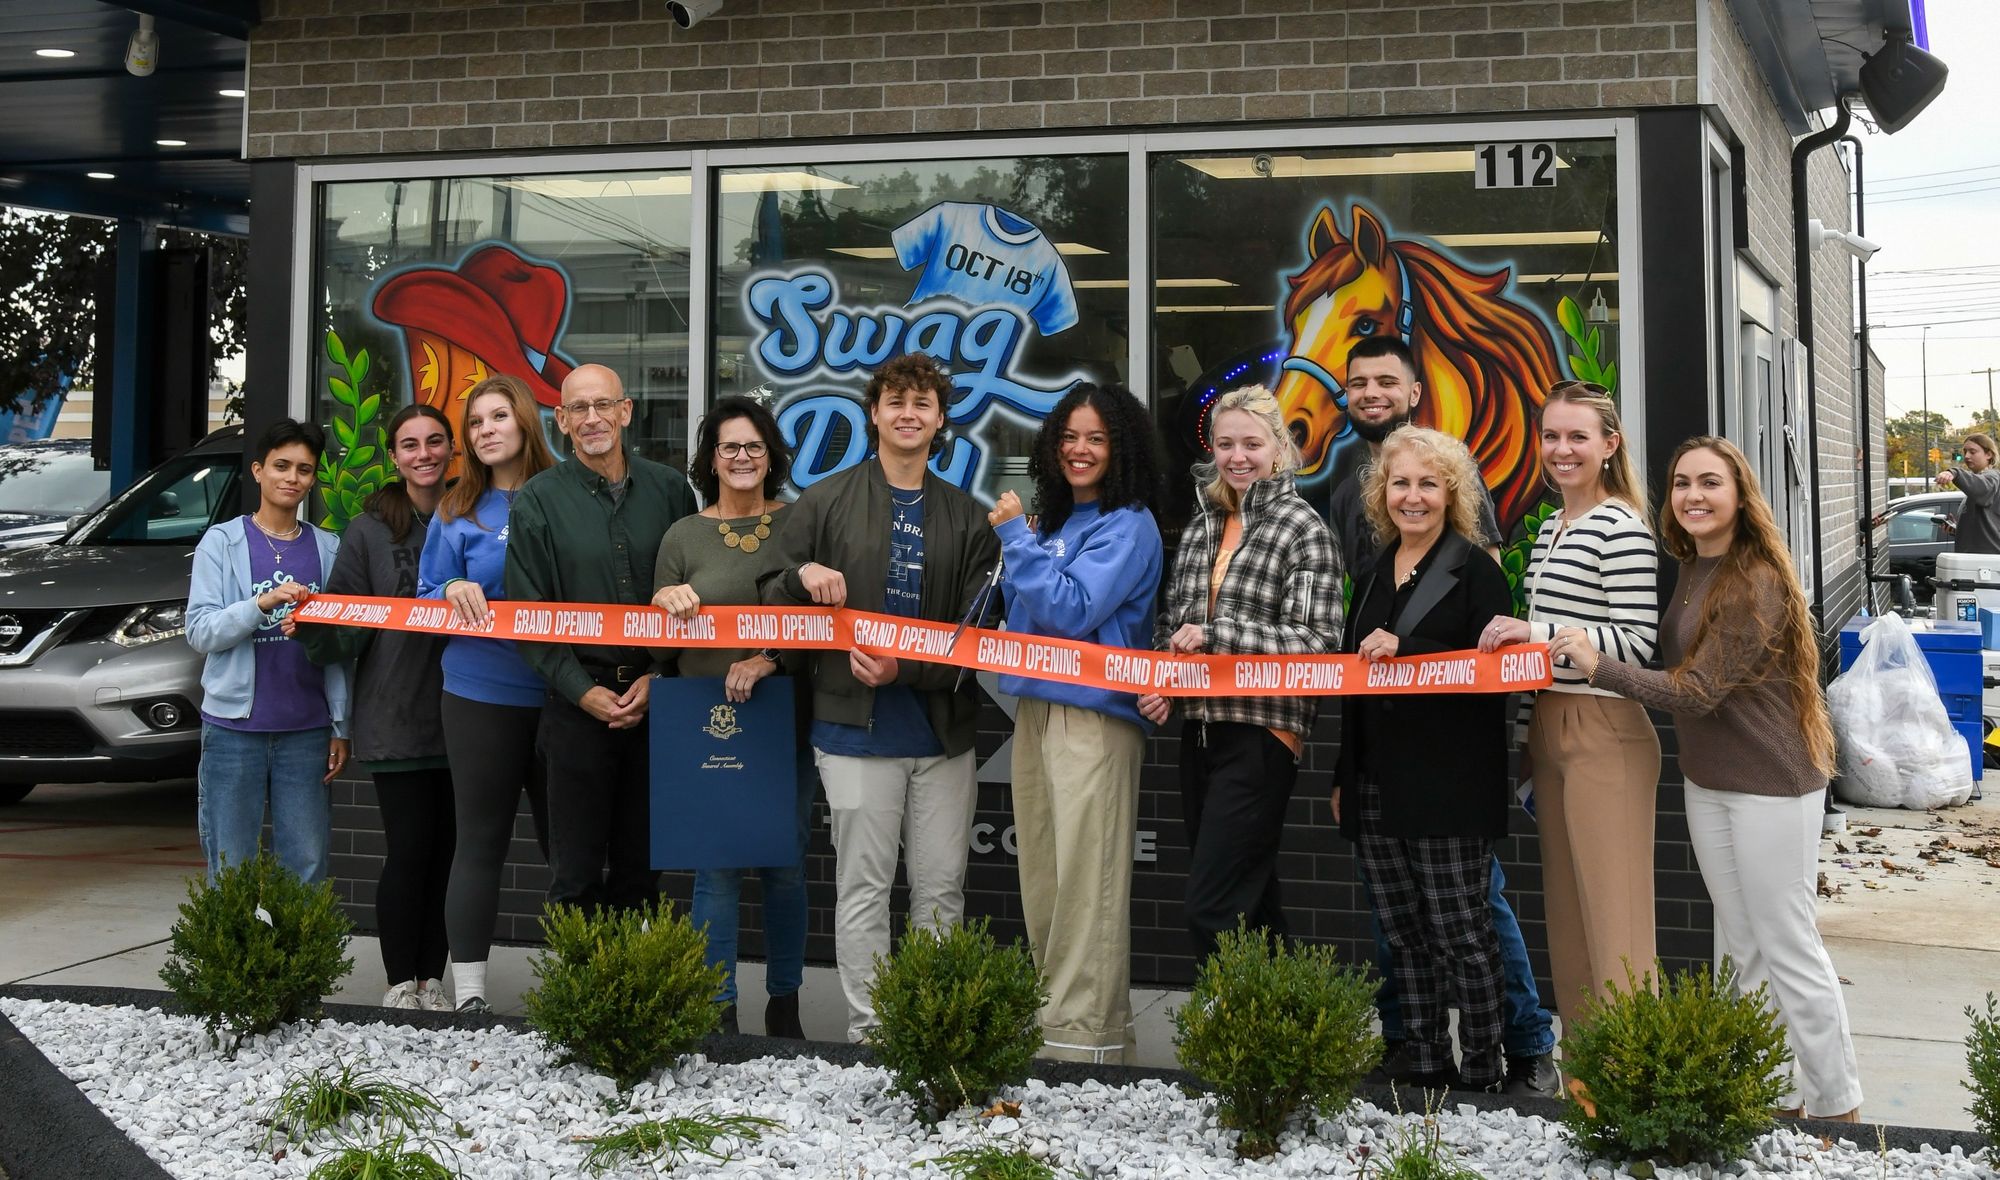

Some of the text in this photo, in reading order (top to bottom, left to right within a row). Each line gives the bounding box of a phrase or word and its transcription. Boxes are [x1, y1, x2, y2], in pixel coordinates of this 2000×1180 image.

[1480, 144, 1554, 187] 112
[945, 243, 1045, 295] OCT 18th
[749, 273, 1086, 425] Swag
[300, 601, 343, 619] GRAND
[339, 604, 392, 624] OPENING
[405, 606, 446, 628] GRAND
[513, 609, 552, 635] GRAND
[554, 611, 604, 637] OPENING
[623, 612, 662, 639] GRAND
[737, 613, 778, 640] GRAND
[781, 615, 834, 642] OPENING
[854, 618, 898, 648] GRAND
[977, 636, 1022, 667] GRAND
[1025, 644, 1081, 676] OPENING
[1105, 653, 1151, 686] GRAND
[1154, 660, 1210, 689] OPENING
[1235, 662, 1282, 689] GRAND
[1285, 662, 1344, 689] OPENING
[1367, 662, 1415, 688] GRAND
[1417, 658, 1476, 686] OPENING
[1501, 651, 1546, 683] GRAND
